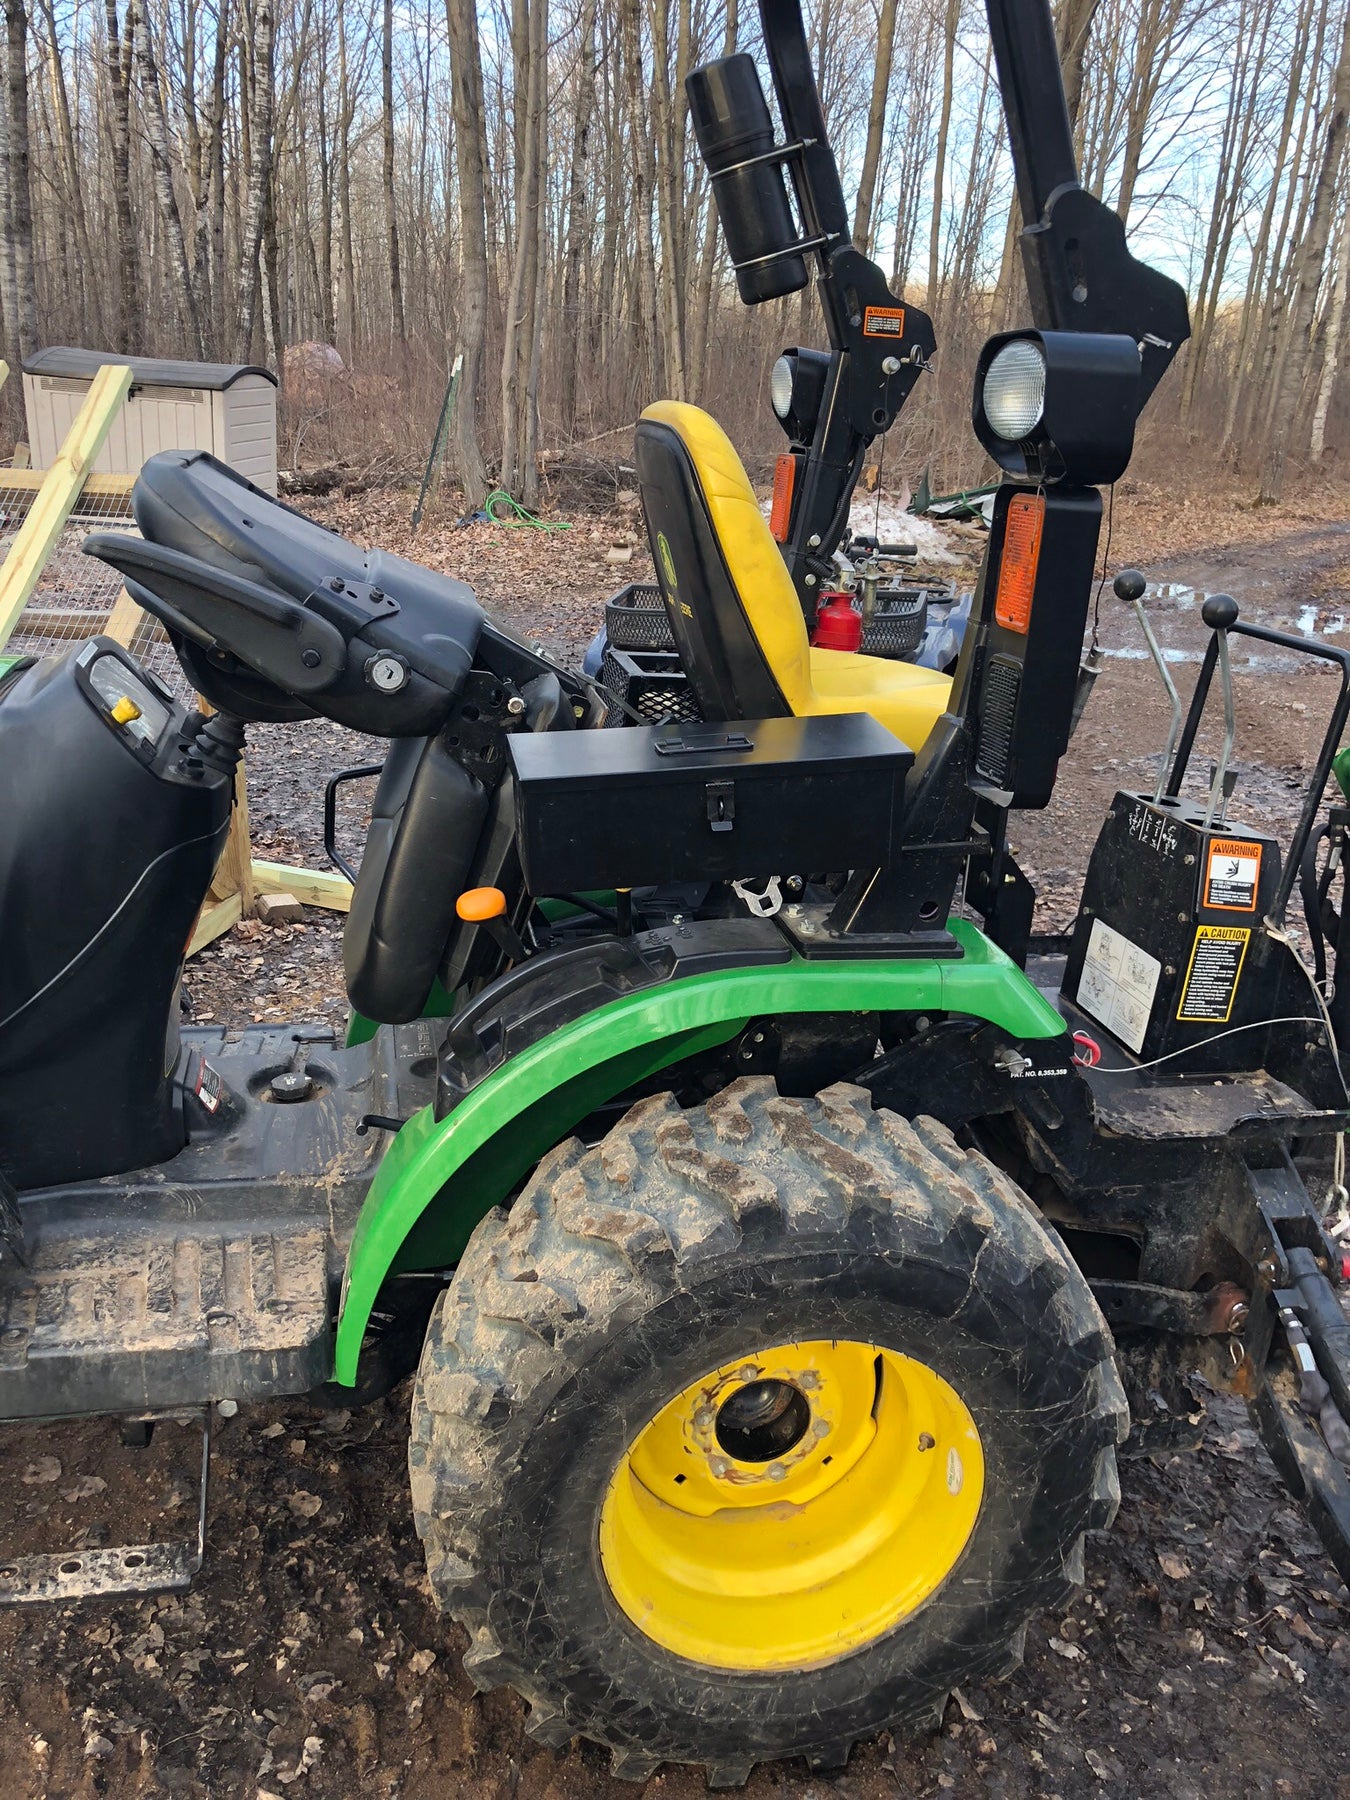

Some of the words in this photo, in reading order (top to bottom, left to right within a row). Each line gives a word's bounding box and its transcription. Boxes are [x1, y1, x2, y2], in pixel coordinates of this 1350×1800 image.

[873, 308, 902, 317] WARNING
[1221, 843, 1259, 858] WARNING
[1210, 928, 1248, 940] CAUTION
[1025, 1070, 1037, 1078] NO.
